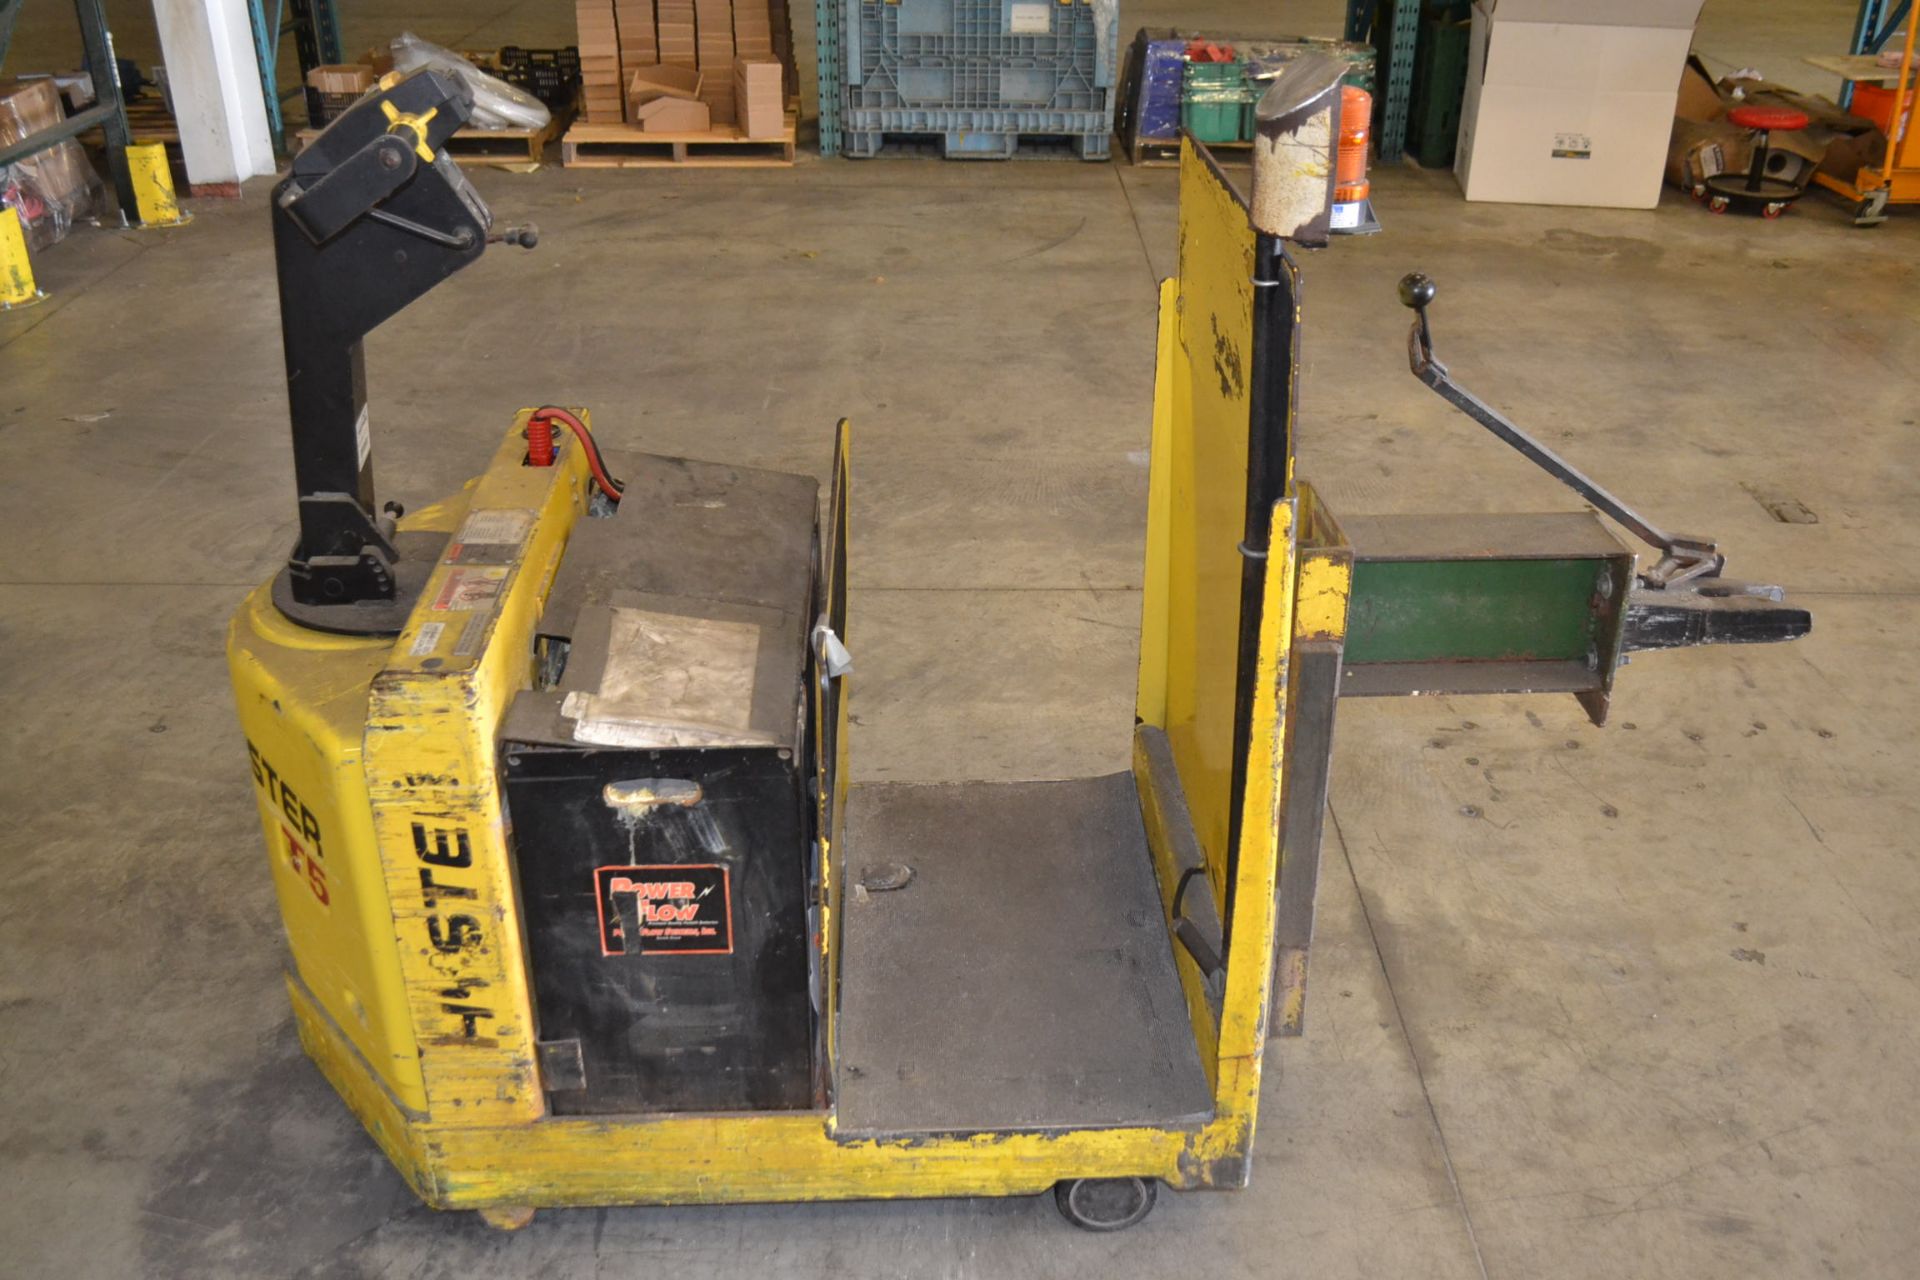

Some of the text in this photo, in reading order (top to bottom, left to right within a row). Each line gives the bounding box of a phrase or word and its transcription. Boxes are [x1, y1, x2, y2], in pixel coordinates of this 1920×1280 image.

[281, 823, 331, 907] T5
[609, 877, 696, 900] POWER
[407, 773, 500, 1048] HYSTE
